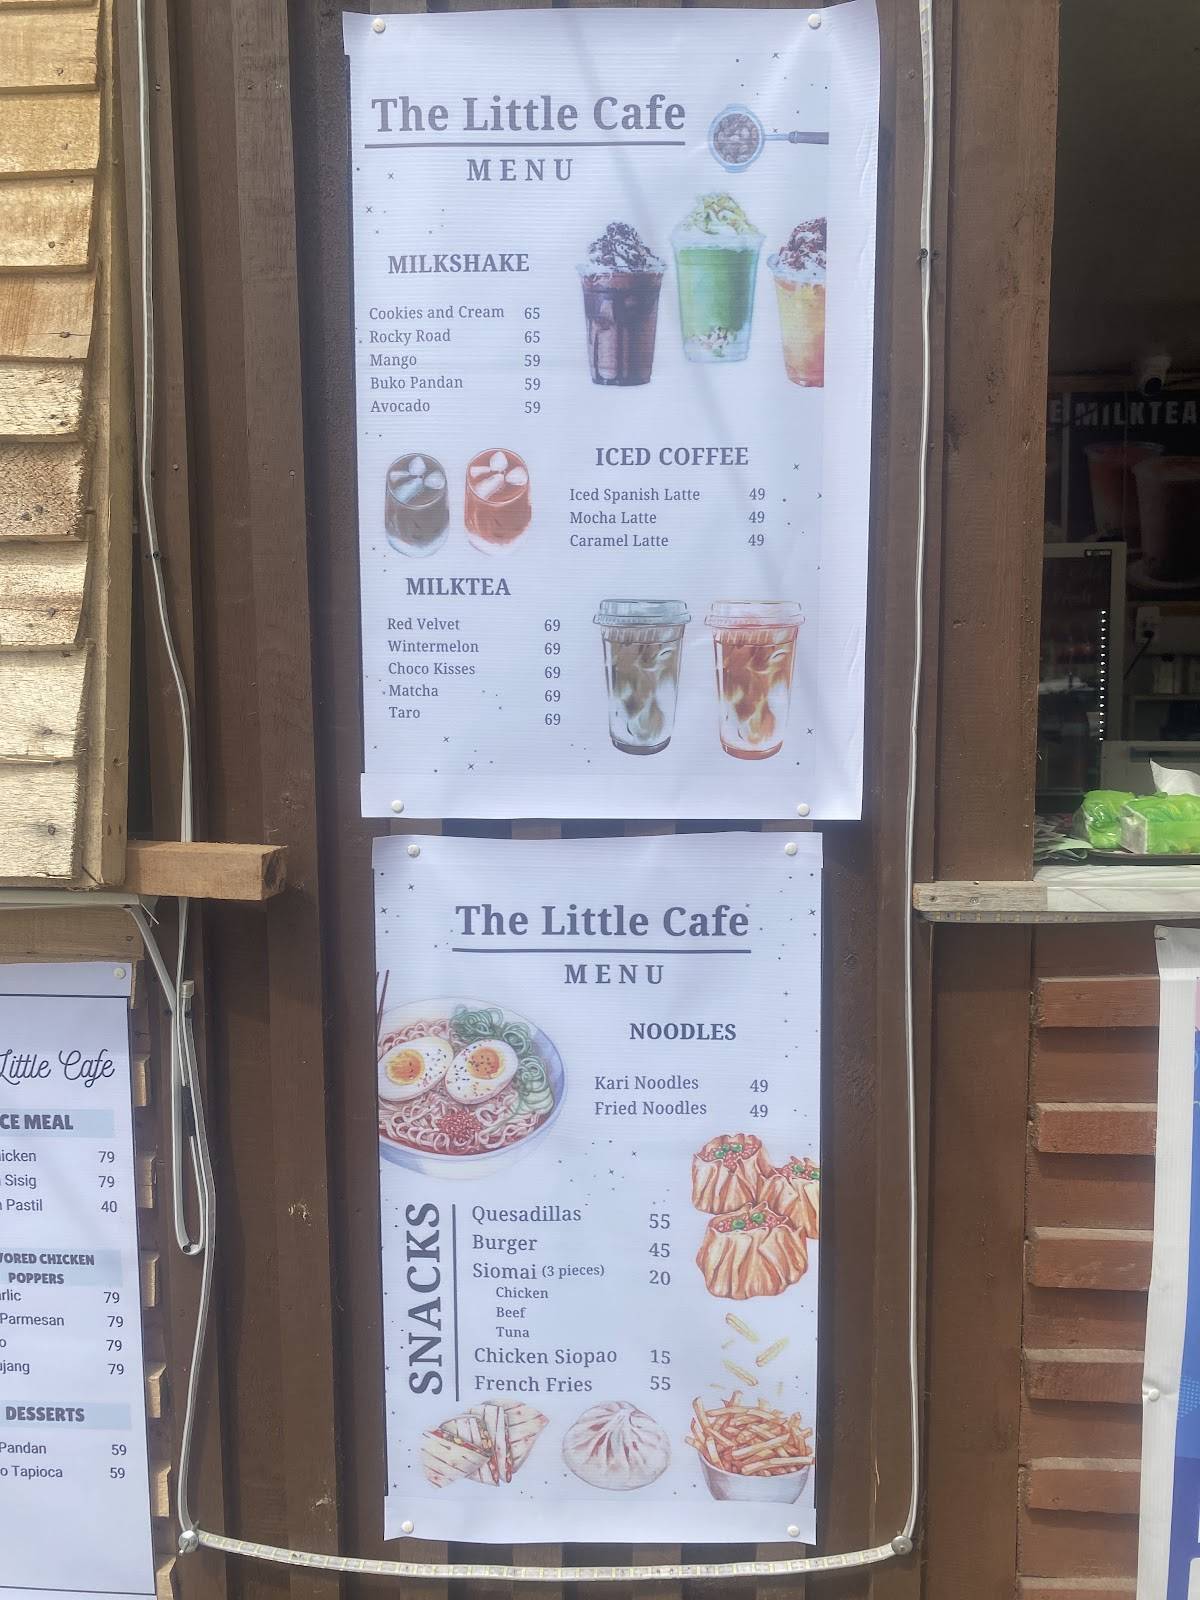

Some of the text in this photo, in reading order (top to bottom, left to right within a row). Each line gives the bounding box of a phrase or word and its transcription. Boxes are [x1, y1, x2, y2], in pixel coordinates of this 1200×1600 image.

[372, 94, 685, 132] The Little Cafe
[467, 159, 573, 181] MENU
[388, 254, 529, 273] MILKSHAKE
[370, 306, 540, 320] Cookies and Cream 65
[369, 329, 540, 346] Rocky Road 65
[370, 354, 540, 369] Mango 59
[371, 376, 540, 390] Buko Pandan 59
[370, 399, 540, 413] Avocado 59
[1075, 401, 1197, 426] MILKTEA
[596, 448, 748, 465] ICED COFFEE
[570, 488, 765, 504] Iced Spanish Latte 49
[570, 511, 764, 523] Mocha Latte 49
[571, 534, 764, 546] Caramel Latte 49
[406, 578, 511, 595] MILKTEA
[388, 618, 560, 631] Red Velvet 69
[388, 640, 560, 655] Wintermelon 69
[389, 662, 560, 678] Choco Kisses 69
[389, 684, 560, 702] Matcha 69
[389, 707, 560, 725] Taro 69
[456, 904, 749, 936] The Little Cafe
[564, 964, 663, 984] MENU
[630, 1023, 736, 1040] NOODLES
[0, 1049, 115, 1088] Little Cafe
[595, 1075, 768, 1092] Kari Noodles 49
[595, 1101, 768, 1117] Fried Noodles 49
[24, 1115, 73, 1130] MEAL
[0, 1149, 114, 1163] icken 79
[5, 1174, 36, 1189] Sisig
[99, 1176, 114, 1187] 79
[7, 1199, 42, 1211] Pastil
[101, 1201, 117, 1212] 40
[472, 1206, 670, 1229] Quesadillas 55
[473, 1235, 670, 1257] Burger 45
[39, 1254, 94, 1265] CHICKEN
[8, 1273, 64, 1284] POPPERS
[473, 1263, 670, 1285] Siomai (3 pieces) 20
[104, 1292, 119, 1303] 79
[406, 1203, 442, 1394] SNACKS
[496, 1287, 548, 1298] Chicken
[0, 1313, 123, 1327] Parmesan 79
[496, 1307, 526, 1318] Beef
[496, 1327, 529, 1337] Tuna
[106, 1340, 122, 1351] 79
[475, 1348, 670, 1367] Chicken Siopao 15
[108, 1364, 124, 1375] 79
[475, 1376, 671, 1392] French Fries 55
[6, 1406, 85, 1422] DESSERTS
[0, 1442, 126, 1455] Pandan 59
[11, 1466, 62, 1480] Tapioca
[111, 1468, 125, 1478] 59
